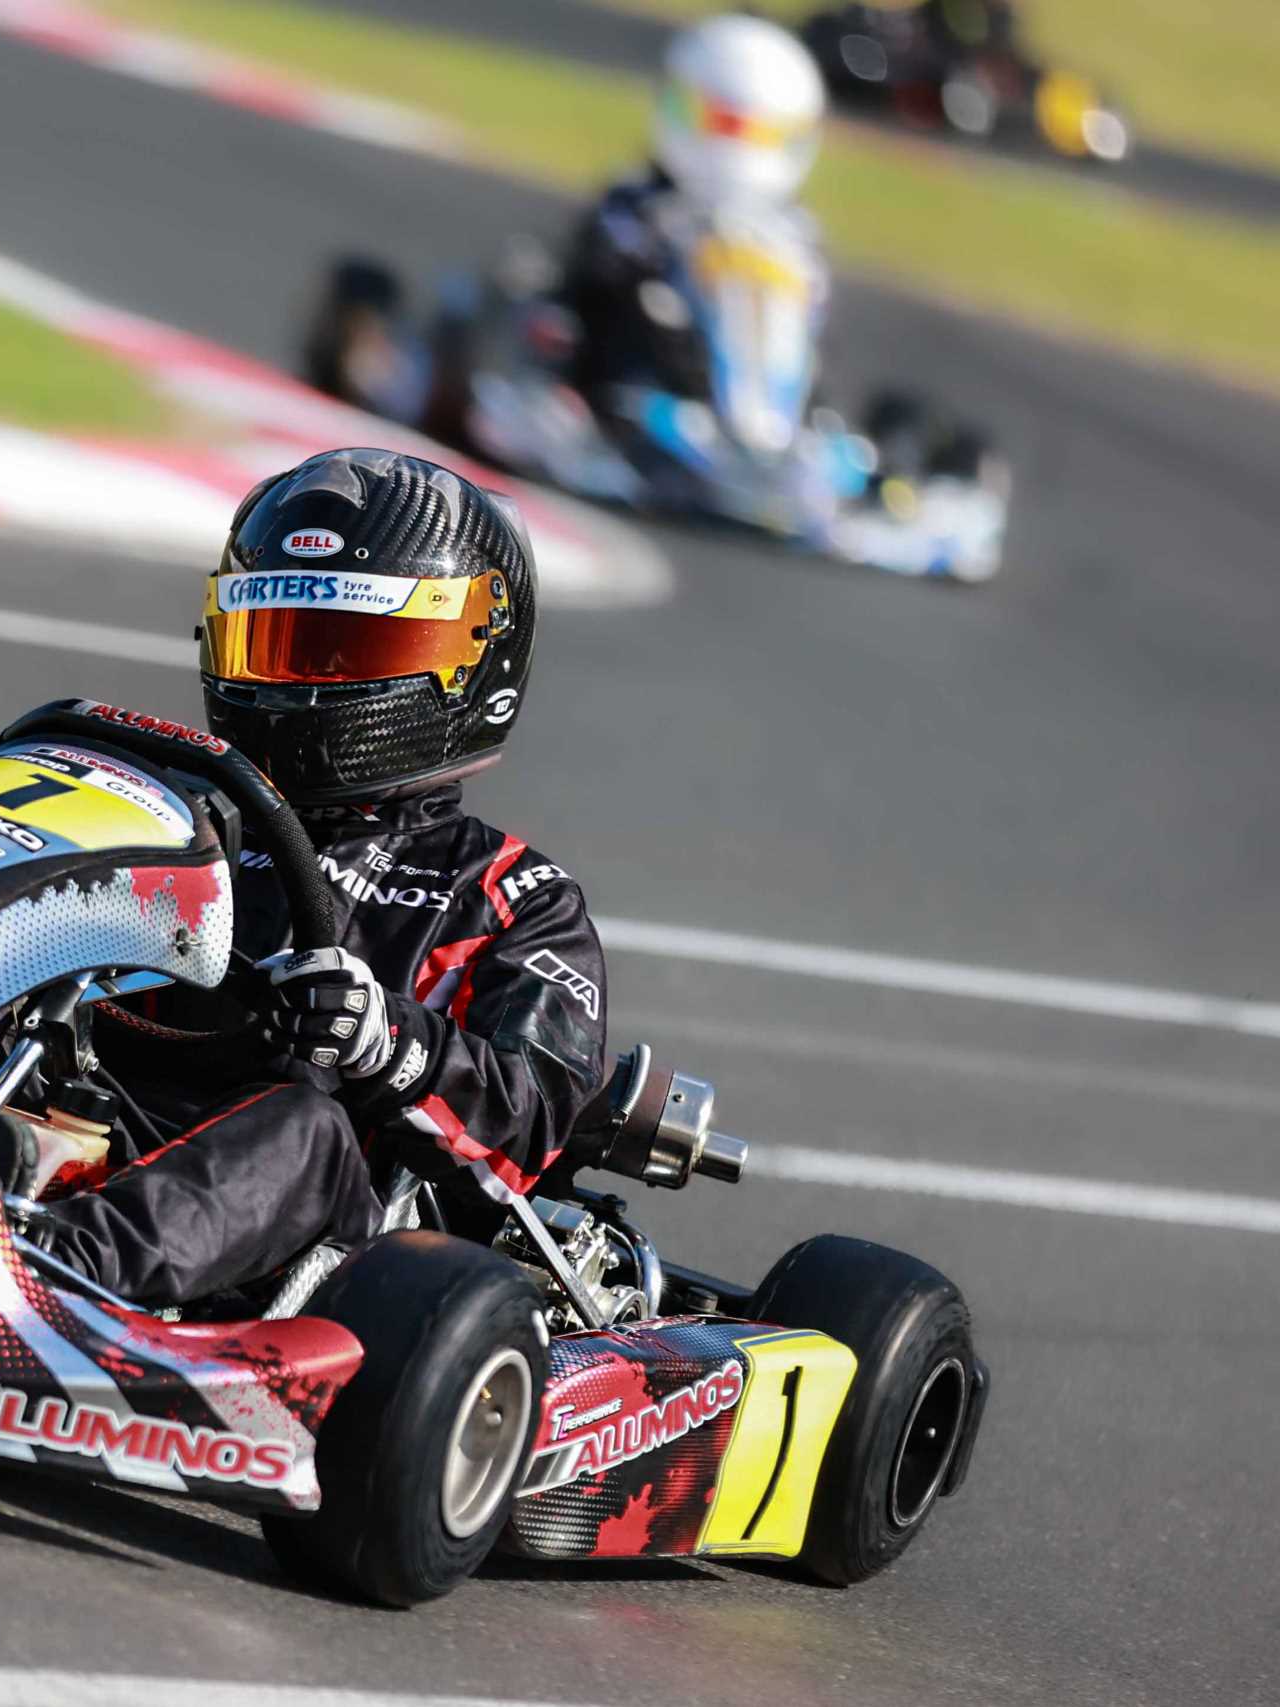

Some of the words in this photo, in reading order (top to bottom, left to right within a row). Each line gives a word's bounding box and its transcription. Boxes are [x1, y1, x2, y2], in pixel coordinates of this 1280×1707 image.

[290, 535, 334, 548] BELL
[229, 574, 339, 605] CARTER'S
[343, 580, 372, 592] tyre
[342, 592, 395, 605] service
[86, 703, 230, 756] ALUMINOS
[106, 780, 171, 822] Group
[316, 854, 455, 913] MINOS
[283, 951, 317, 971] OMP
[391, 1041, 426, 1089] OMP
[571, 1360, 744, 1479] ALUMINOS
[741, 1364, 803, 1541] 1
